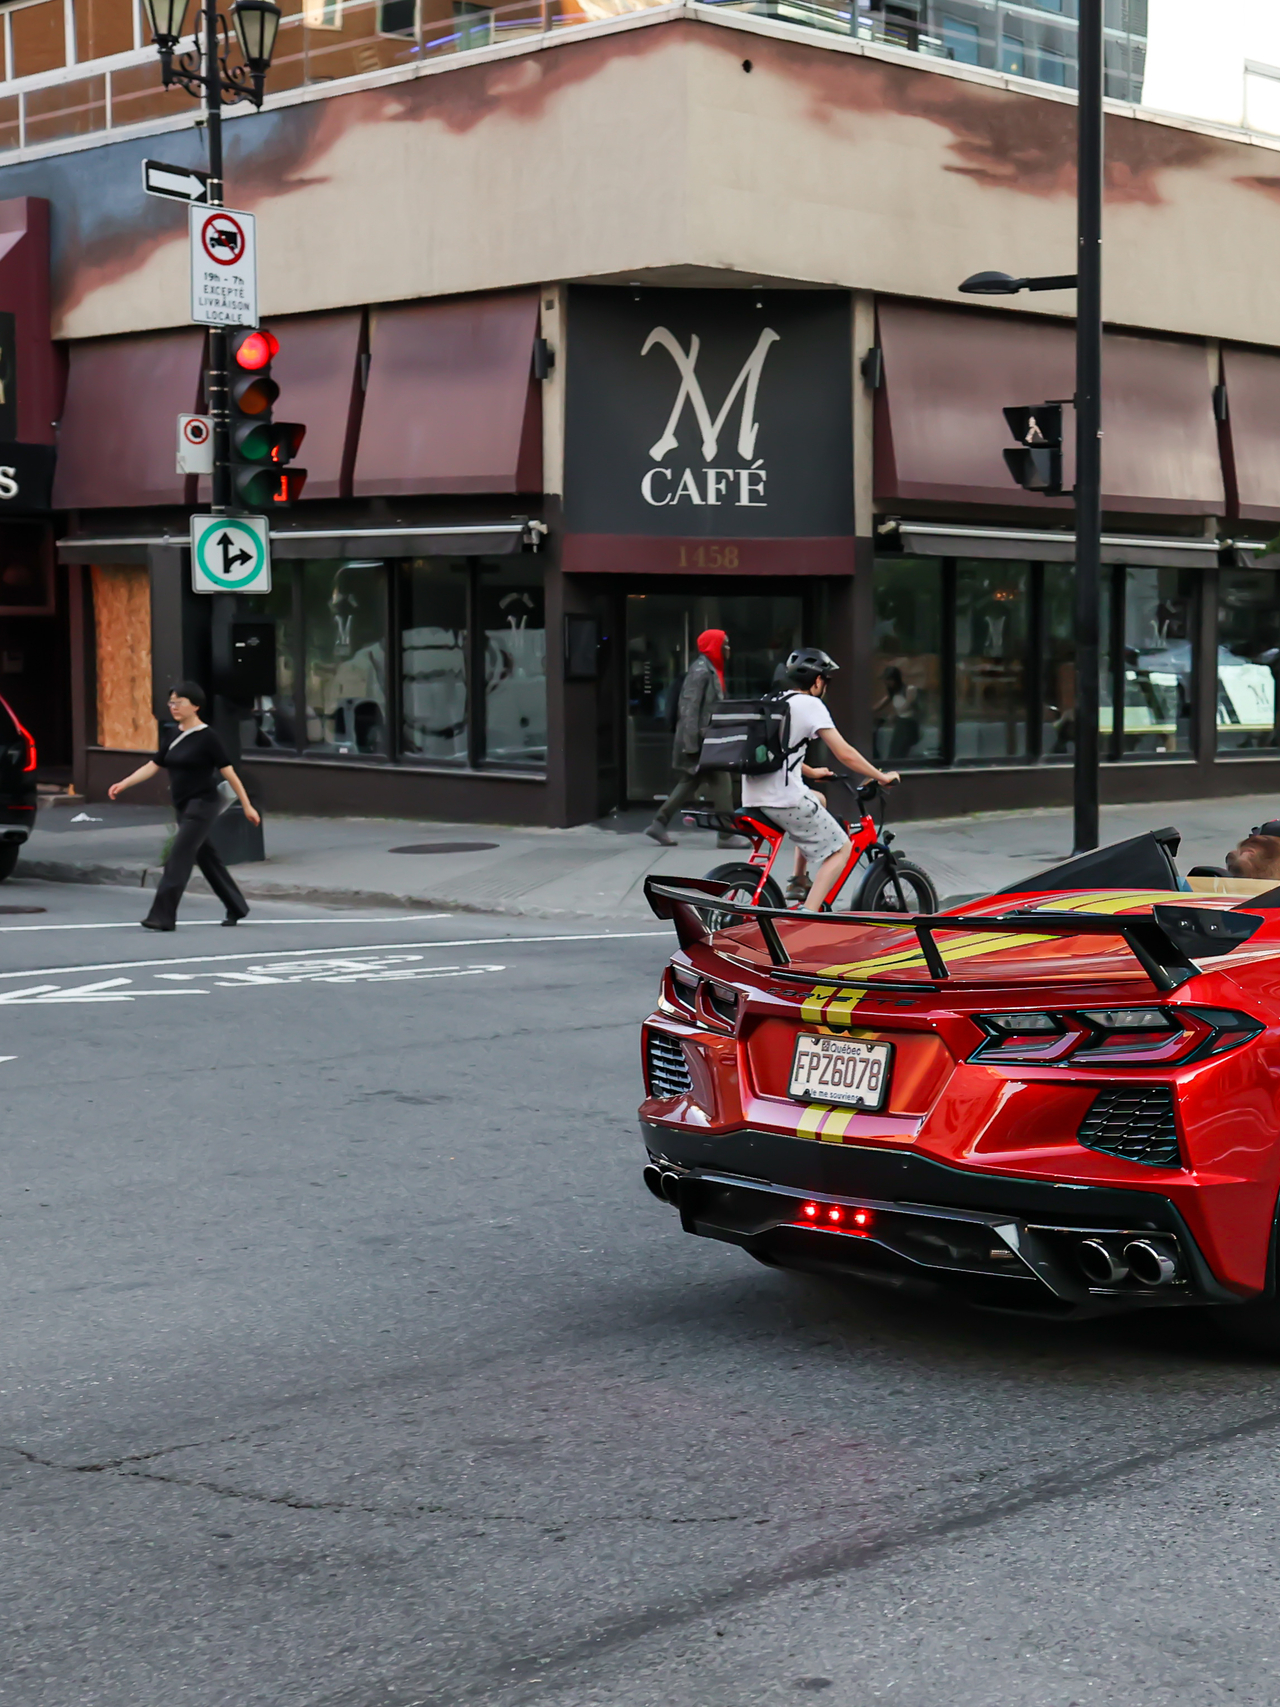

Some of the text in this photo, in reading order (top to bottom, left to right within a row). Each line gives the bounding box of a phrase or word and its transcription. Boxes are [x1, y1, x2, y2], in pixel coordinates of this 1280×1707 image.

[204, 272, 221, 282] 19h
[232, 276, 245, 285] 7h
[203, 284, 245, 298] EXCEPTÉ
[199, 297, 250, 310] LIVRAISON
[206, 310, 243, 322] LOCALE
[640, 326, 781, 462] M
[640, 459, 768, 506] CAFÉ
[678, 545, 740, 569] 1458
[766, 987, 921, 1007] CORVETTE
[831, 1043, 861, 1056] Québec
[794, 1051, 882, 1092] FPZ6078
